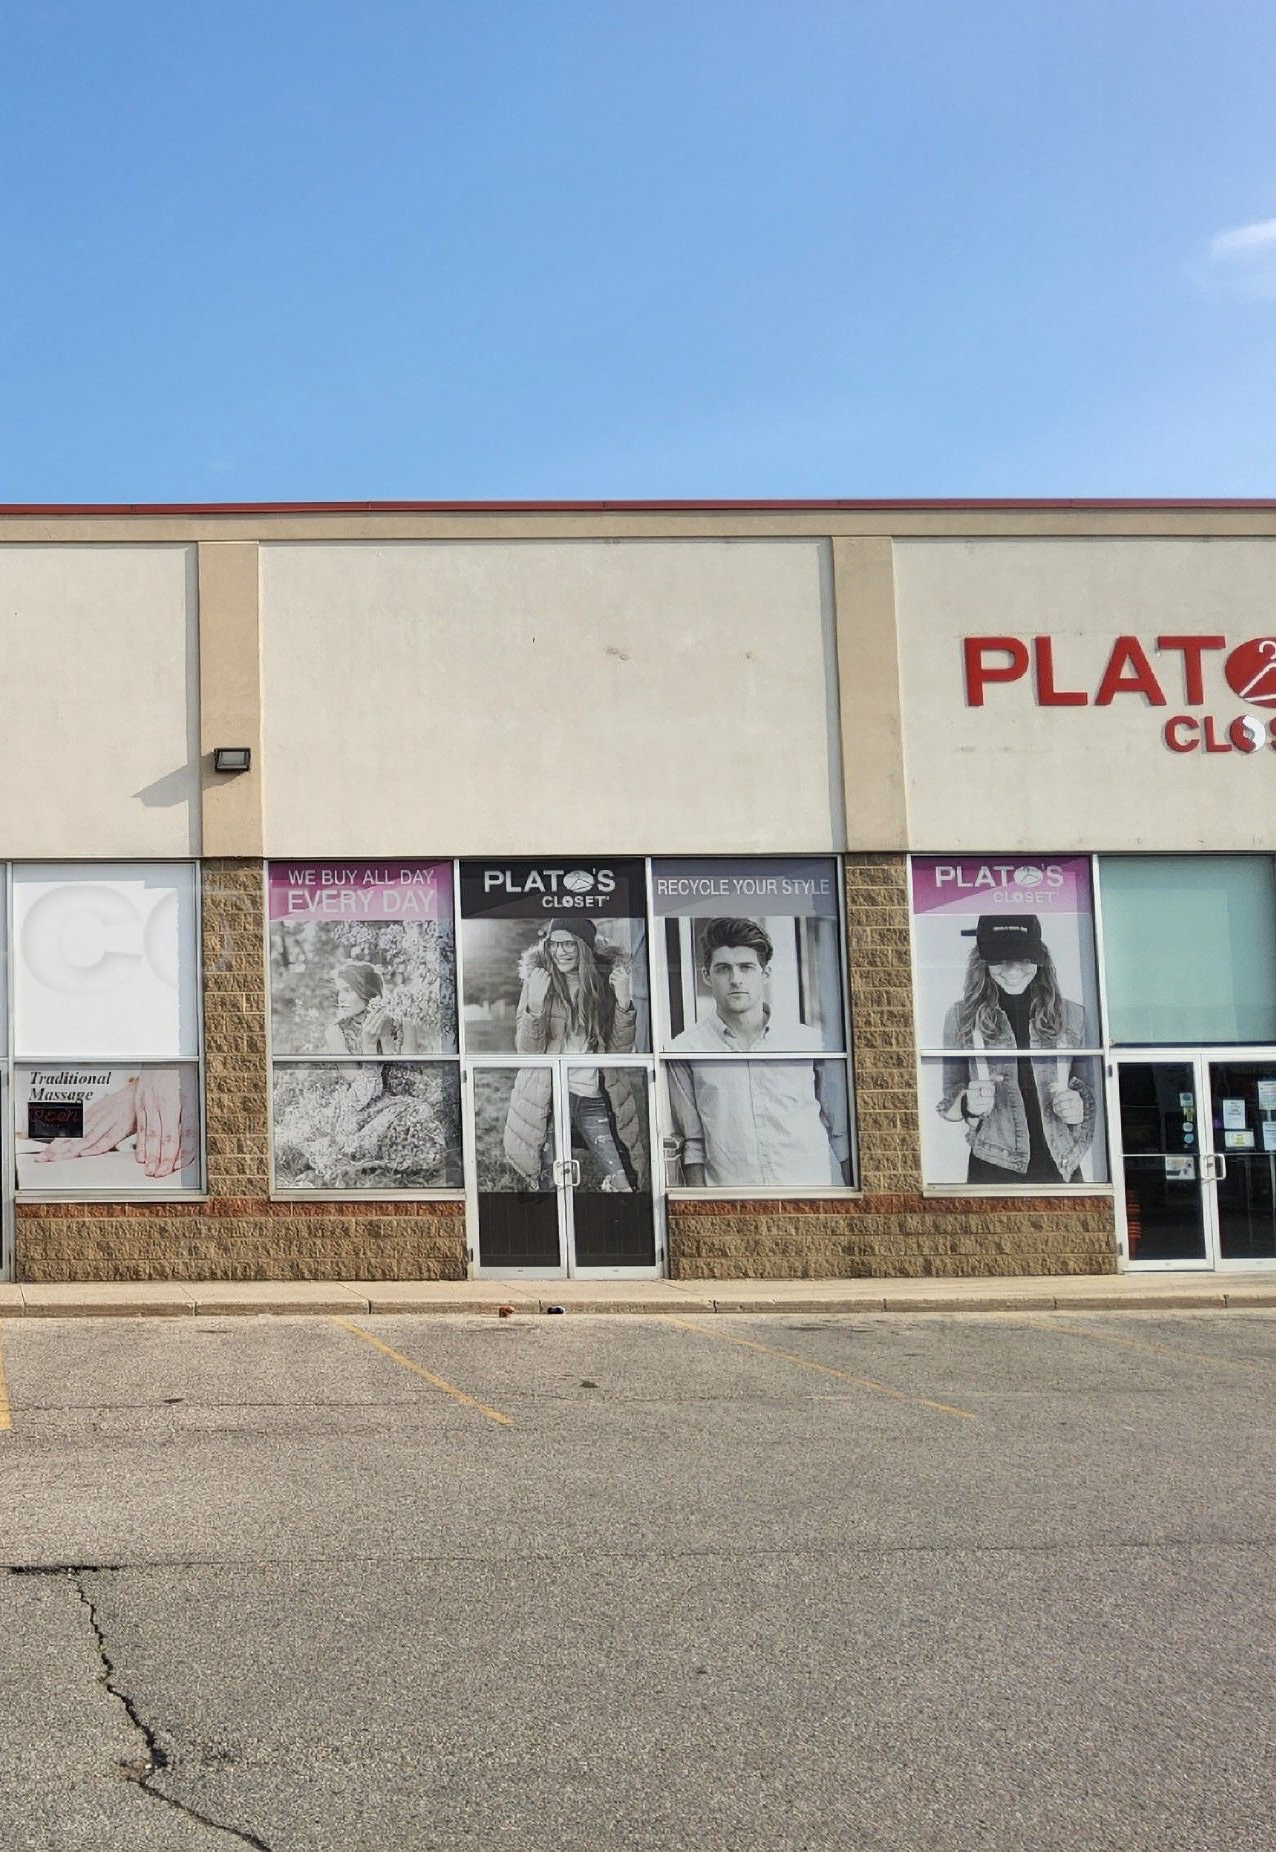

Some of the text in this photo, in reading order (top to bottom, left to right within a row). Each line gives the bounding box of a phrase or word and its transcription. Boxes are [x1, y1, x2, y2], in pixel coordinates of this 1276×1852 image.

[1164, 715, 1276, 753] CLO
[288, 869, 434, 885] WE BUY ALL DAY
[484, 867, 616, 893] PLATO'S
[935, 864, 1065, 888] PLATO'S
[657, 879, 830, 896] RECYCLE YOUR STYLE
[288, 890, 434, 913] EVERY DAY
[541, 895, 606, 908] CLOSET
[993, 891, 1056, 904] CLOSET
[30, 1071, 112, 1085] Traditional
[29, 1087, 94, 1104] Massage
